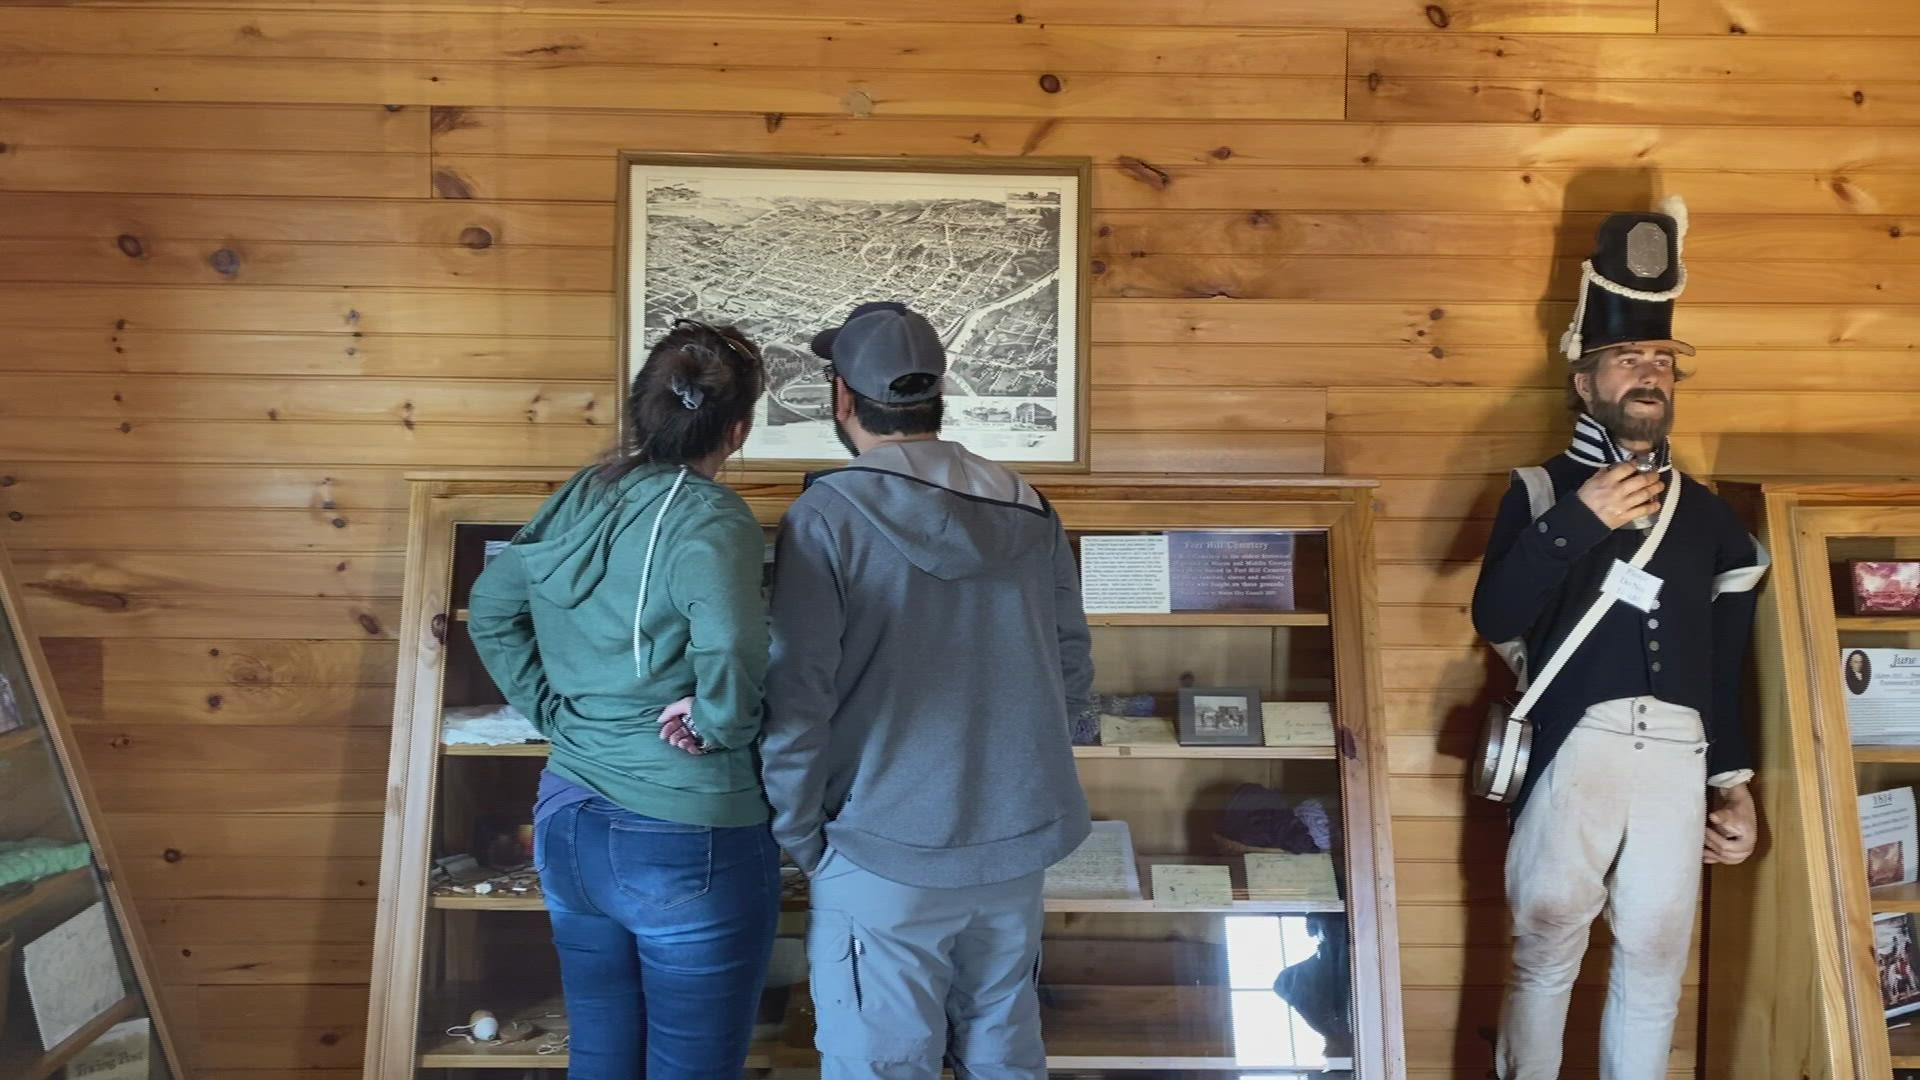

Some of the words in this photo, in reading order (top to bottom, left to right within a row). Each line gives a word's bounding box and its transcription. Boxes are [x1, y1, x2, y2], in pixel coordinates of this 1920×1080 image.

[1184, 541, 1203, 549] Fort
[1207, 541, 1224, 549] Hill
[1226, 541, 1269, 551] Cemetery
[1890, 653, 1915, 667] June
